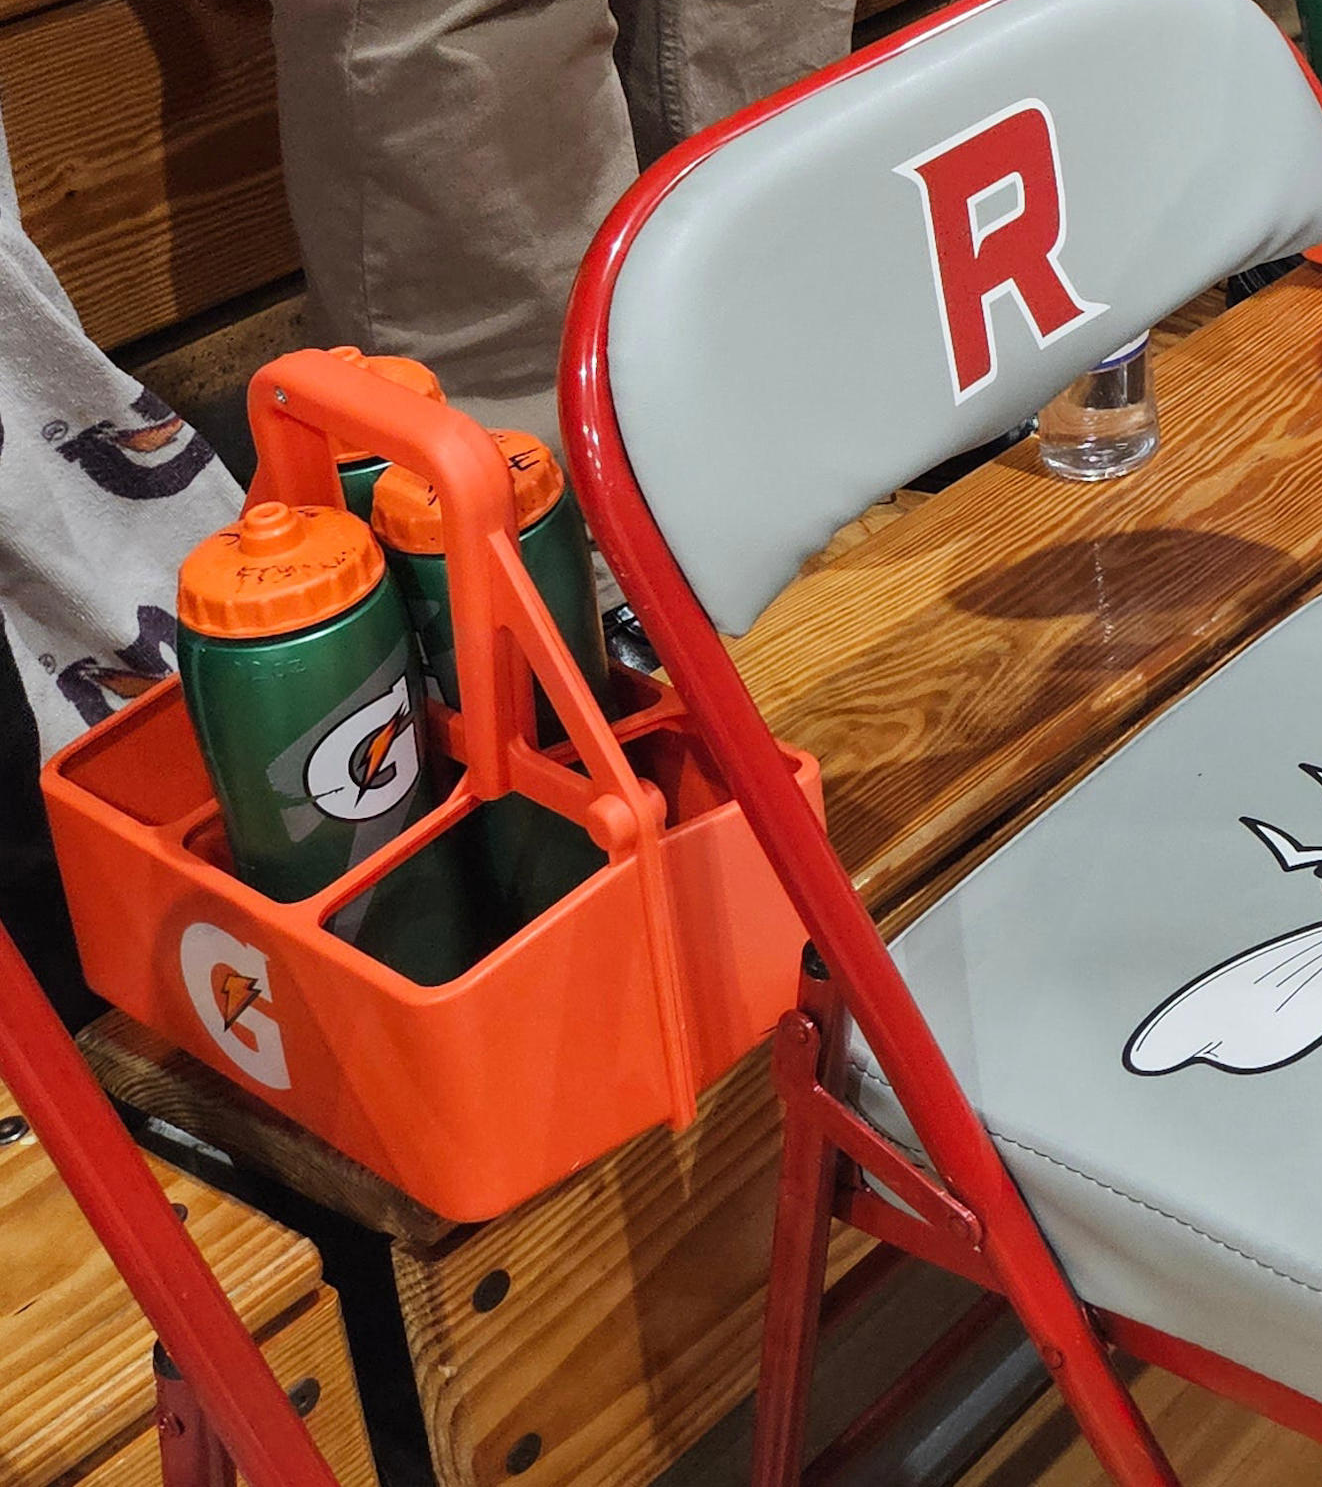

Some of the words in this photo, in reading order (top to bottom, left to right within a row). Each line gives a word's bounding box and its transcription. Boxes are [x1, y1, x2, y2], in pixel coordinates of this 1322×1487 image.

[891, 97, 1111, 406] R
[304, 672, 421, 823] G
[180, 922, 292, 1090] G
